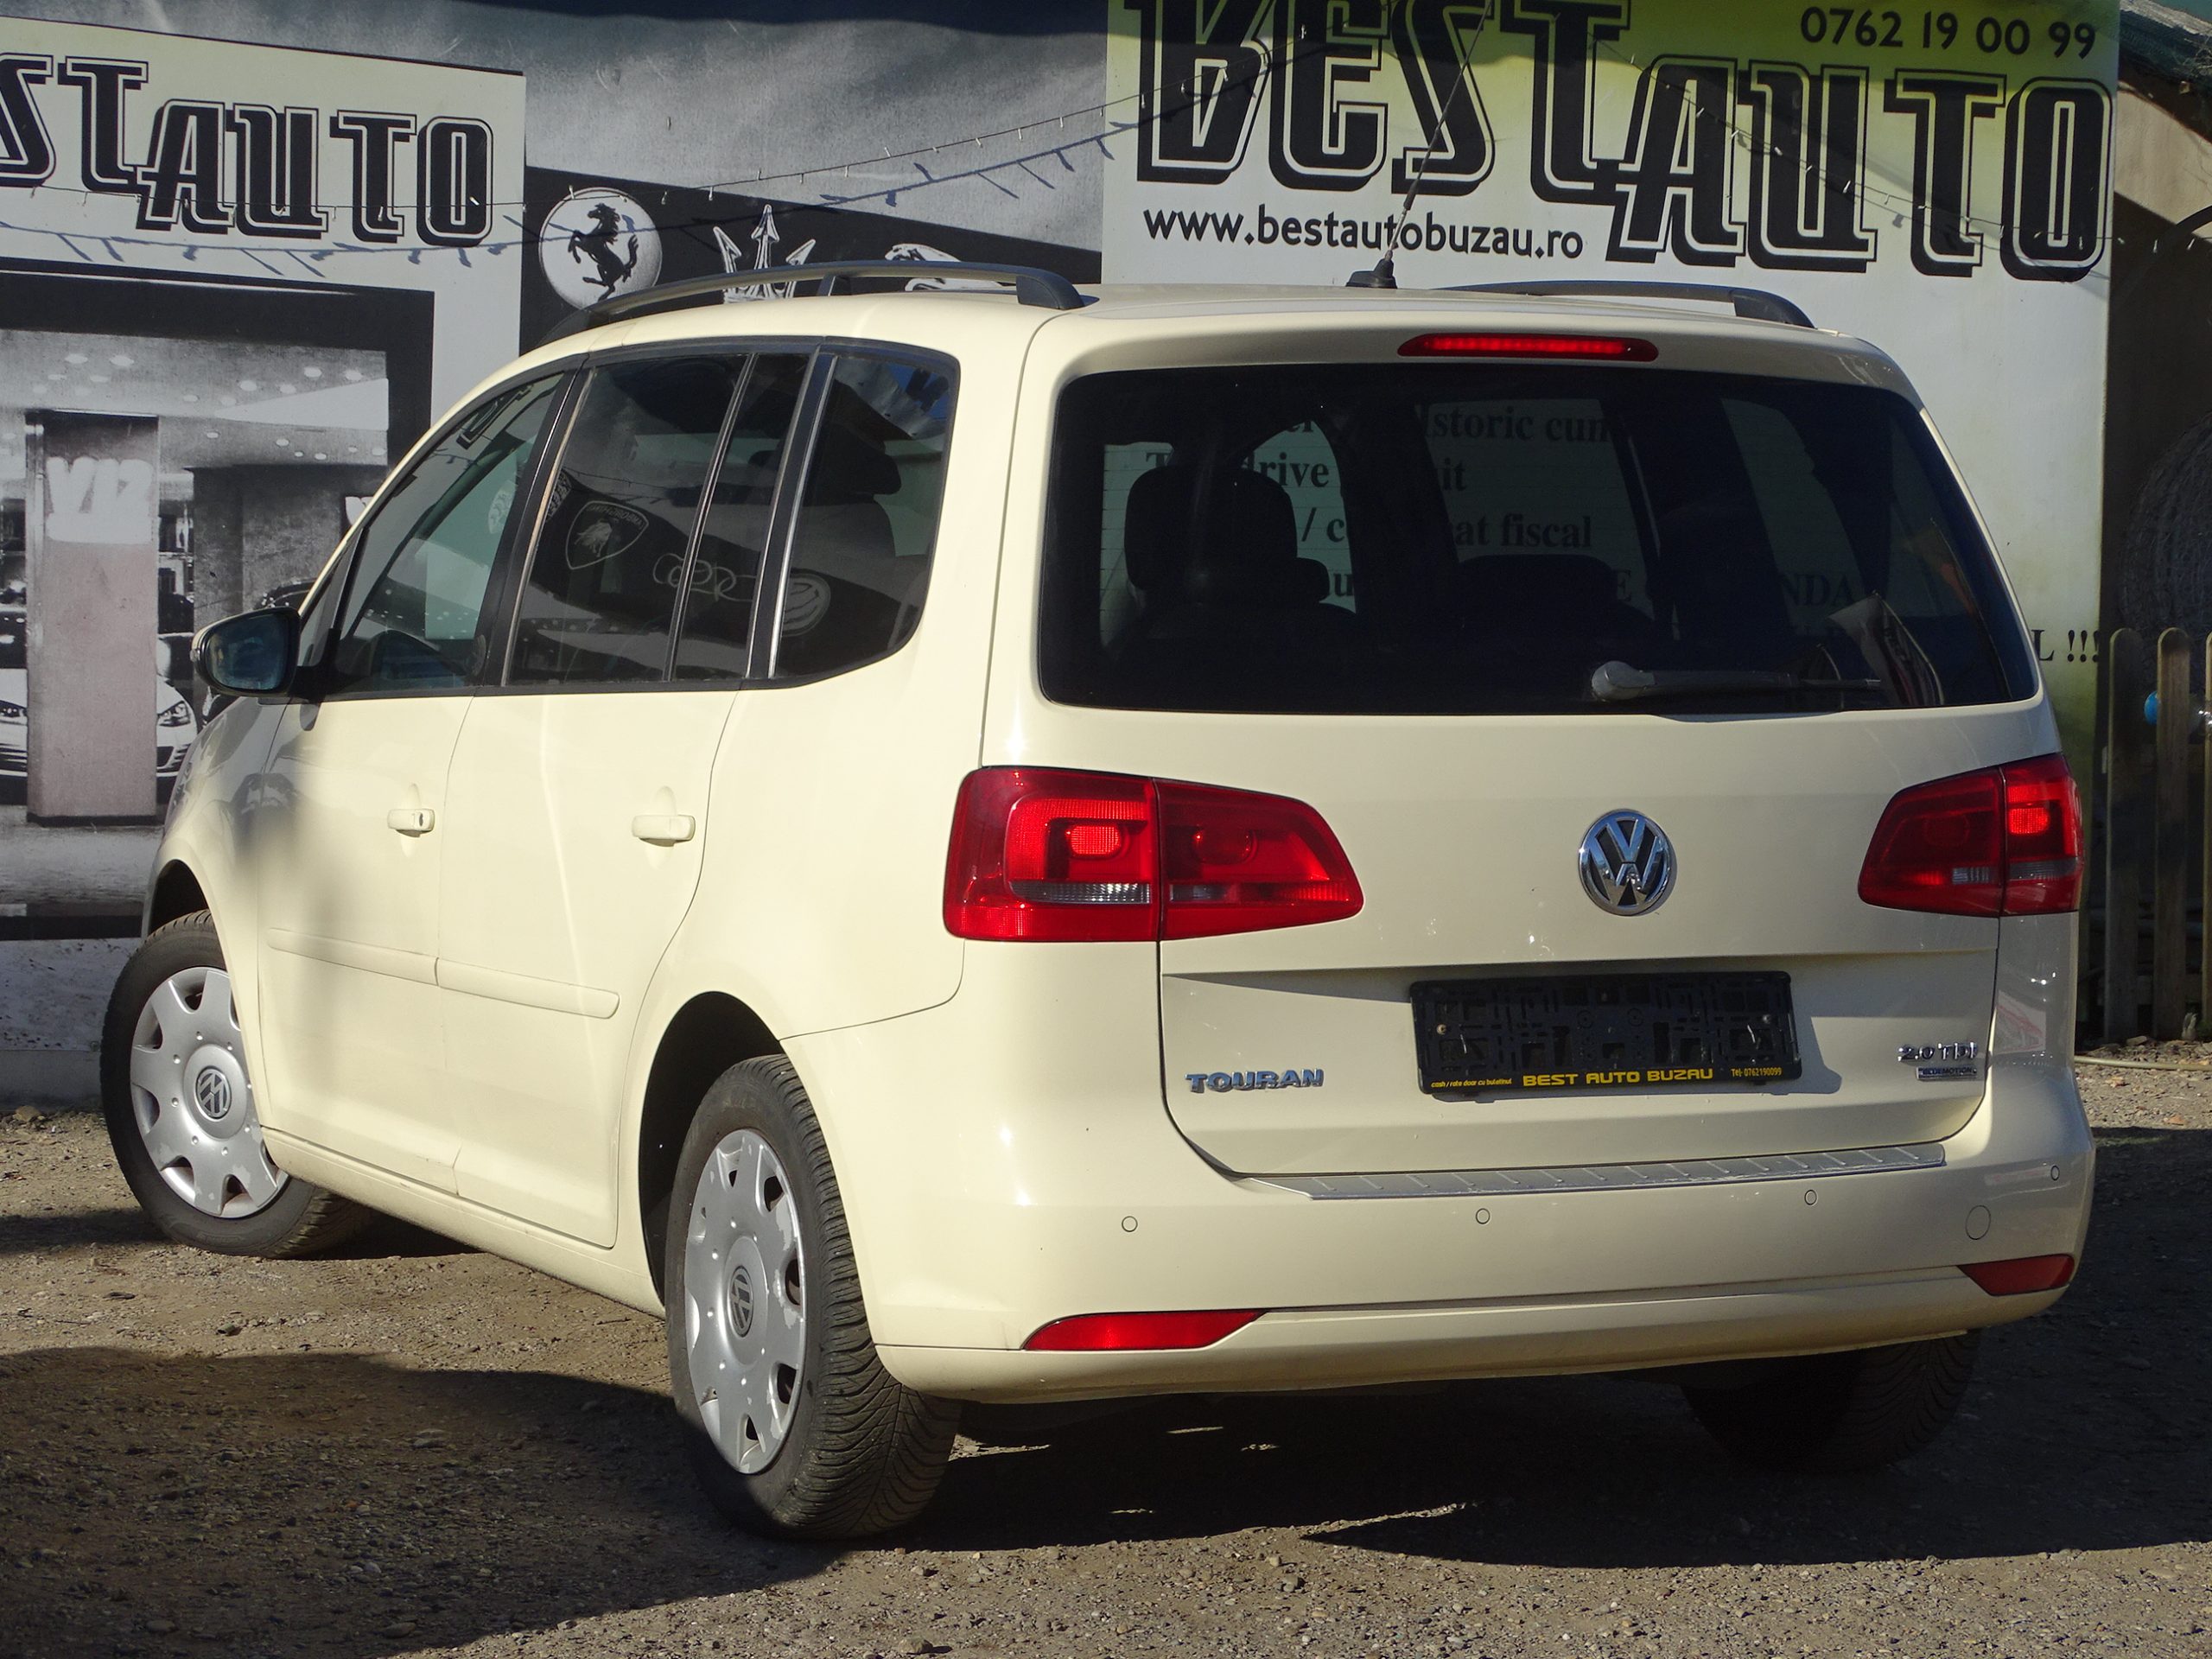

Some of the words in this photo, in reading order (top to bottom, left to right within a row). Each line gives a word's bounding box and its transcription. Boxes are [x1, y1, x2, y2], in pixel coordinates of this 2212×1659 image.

[1801, 7, 1903, 48] 0762
[1923, 11, 1959, 49] 19
[1976, 16, 2031, 55] 00
[2048, 22, 2096, 59] 99
[1142, 204, 1583, 258] www.bestautobuzau.ro
[1500, 512, 1592, 549] fiscal
[1185, 1068, 1324, 1093] TOURAN
[1522, 1074, 1579, 1087] BEST
[1586, 1071, 1640, 1084] AUTO
[1646, 1068, 1713, 1082] BUZAU
